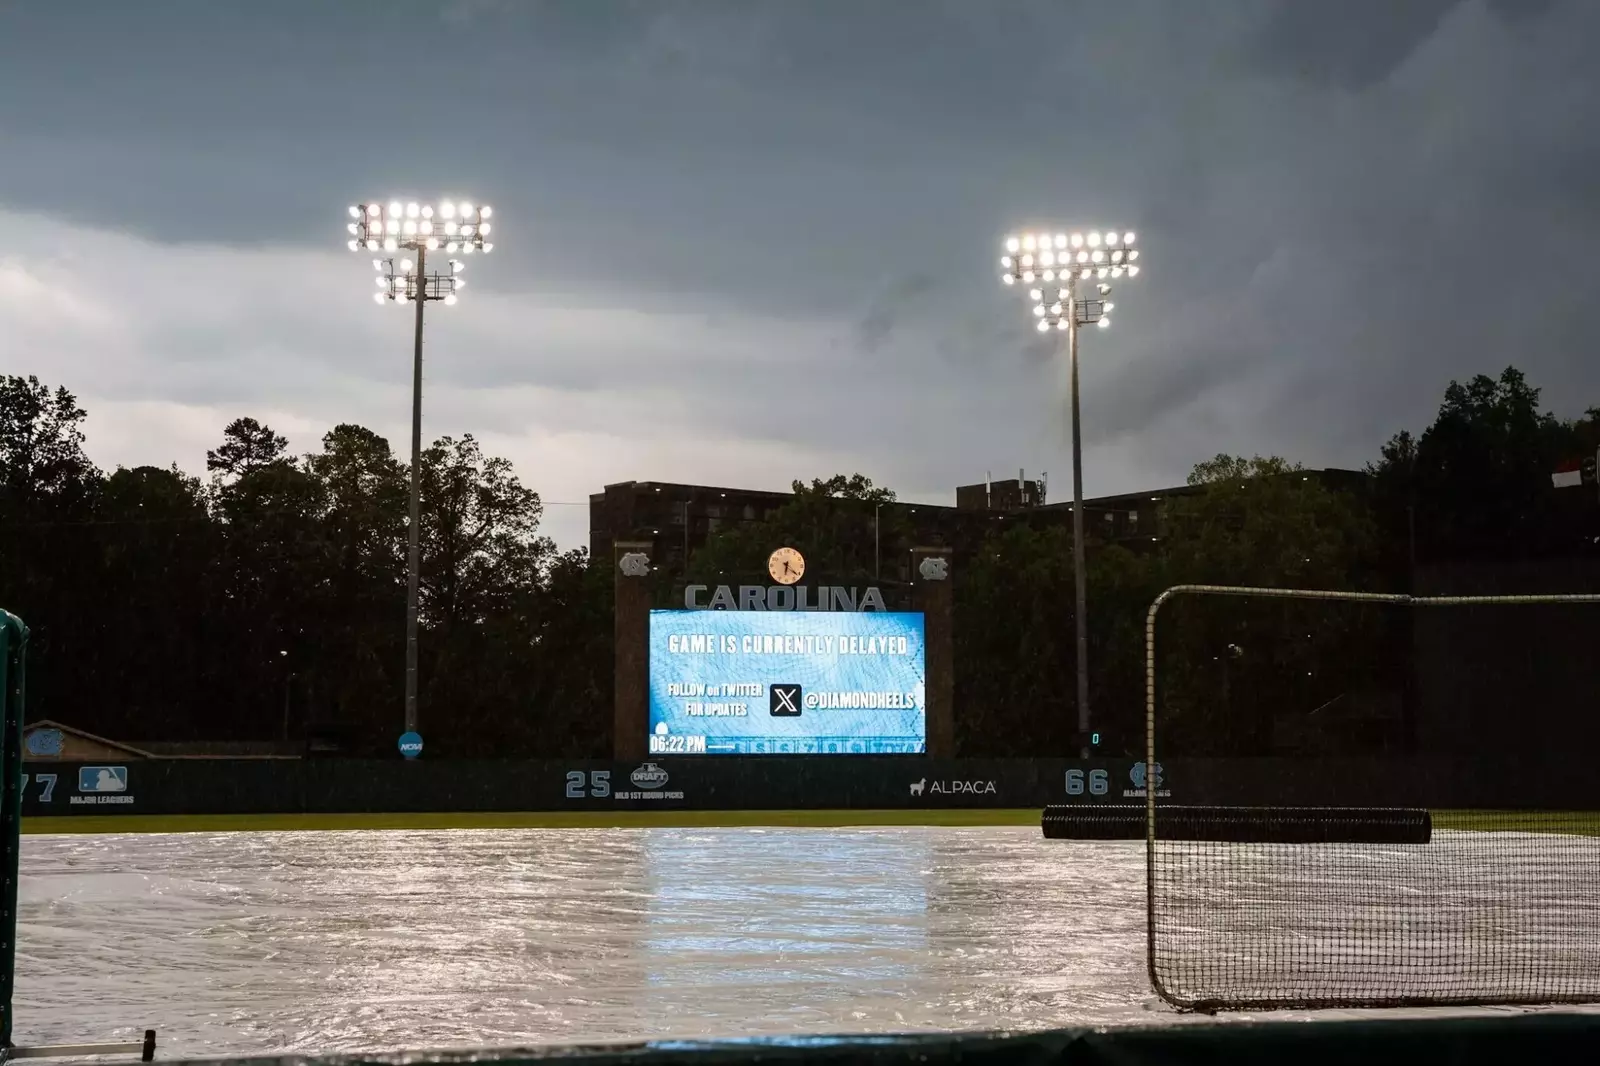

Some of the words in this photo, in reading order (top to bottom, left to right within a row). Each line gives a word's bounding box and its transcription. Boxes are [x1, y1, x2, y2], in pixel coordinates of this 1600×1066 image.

[684, 585, 887, 611] CAROLINA
[668, 634, 715, 654] GAME
[720, 634, 737, 654] IS
[742, 635, 833, 654] CURRENTLY
[839, 636, 907, 655] DELAYED
[668, 683, 707, 697] FOLLOW
[708, 686, 720, 697] on
[721, 683, 763, 697] TWITTER
[804, 691, 916, 710] @DIAMONDHEELS
[686, 702, 704, 716] FOR
[705, 702, 748, 717] UPDATES
[400, 743, 423, 751] NCAA
[650, 736, 684, 752] 06:22
[686, 736, 706, 752] PM
[633, 772, 666, 781] DRAFT
[1065, 769, 1109, 795] 66
[566, 771, 611, 798] 25
[930, 780, 997, 794] ALPACA
[630, 791, 642, 799] 1ST
[664, 791, 684, 799] PICKS
